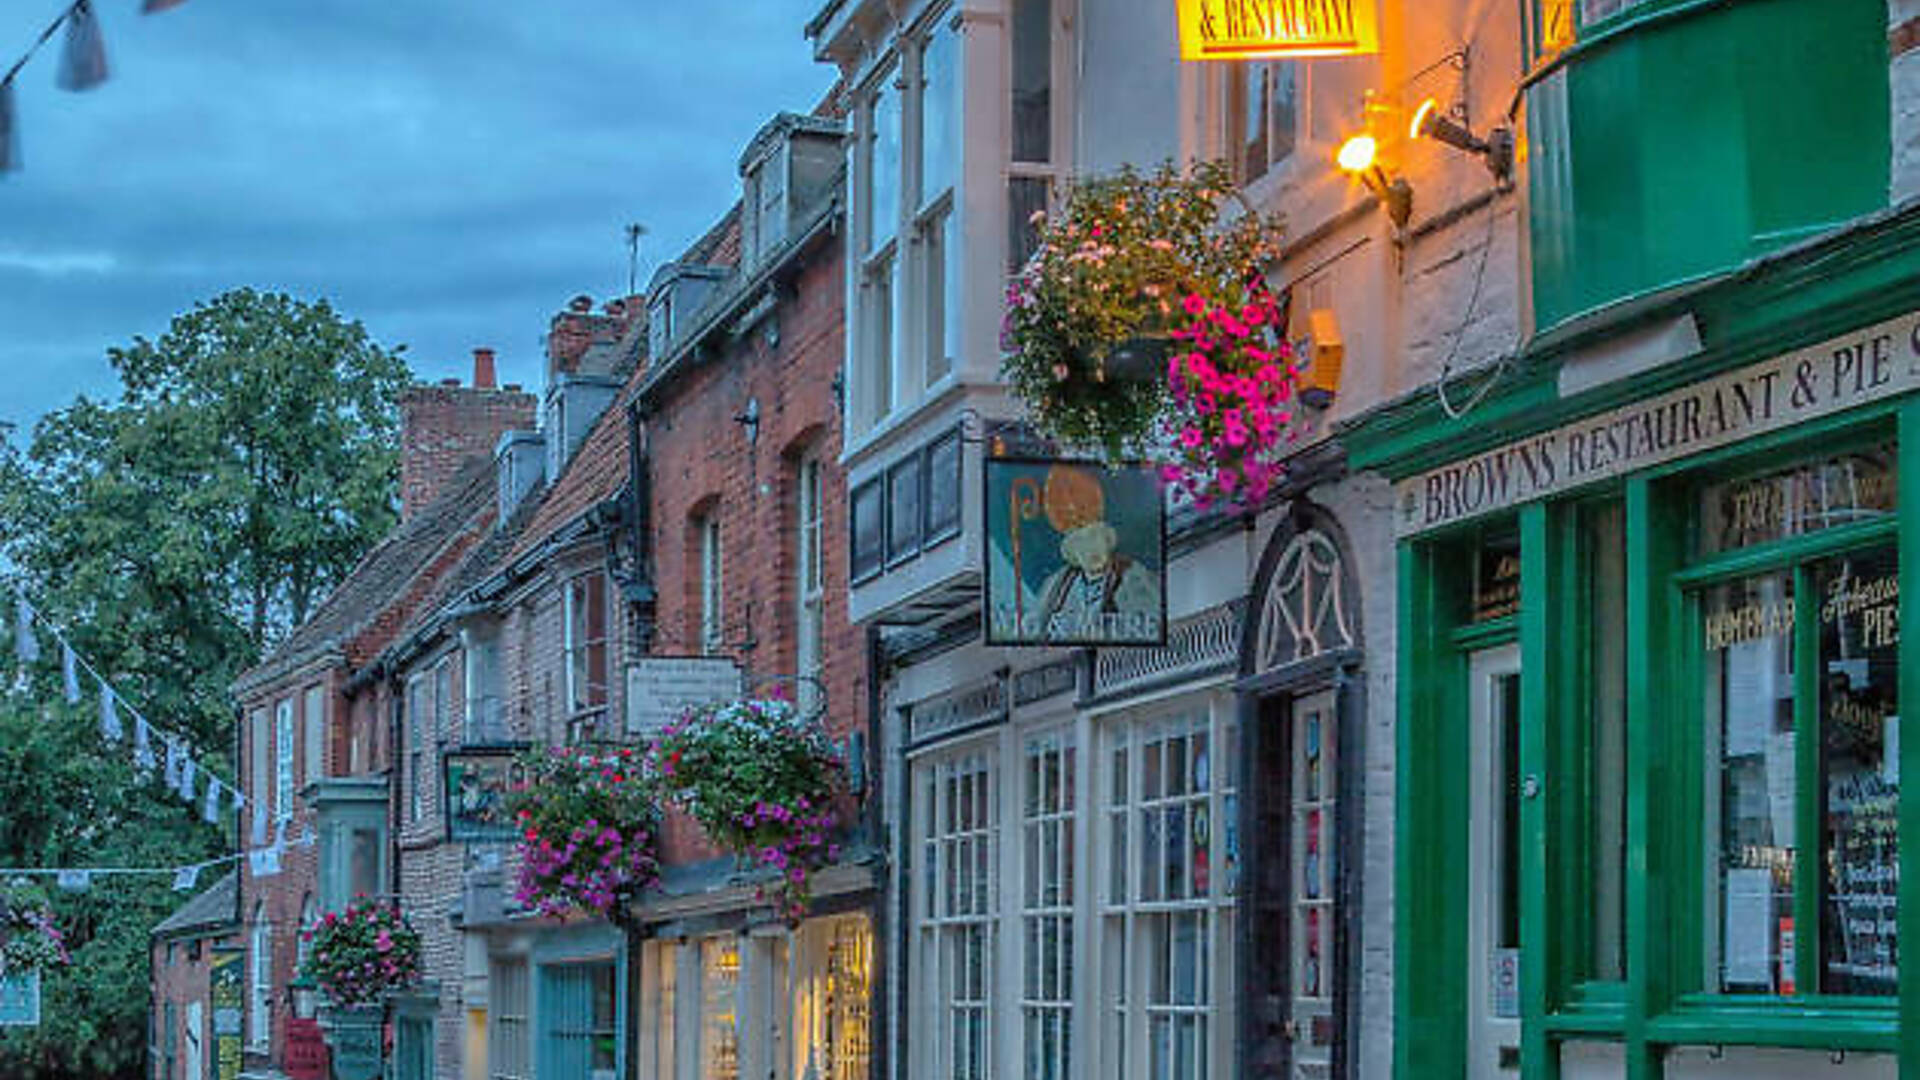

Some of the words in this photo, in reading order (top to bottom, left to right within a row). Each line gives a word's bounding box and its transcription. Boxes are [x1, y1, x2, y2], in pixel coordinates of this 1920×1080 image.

[1200, 0, 1216, 40] &
[1425, 435, 1555, 525] BROWNS
[1567, 370, 1781, 477] RESTAURANT
[1790, 359, 1818, 409] &
[1832, 335, 1890, 397] PIE
